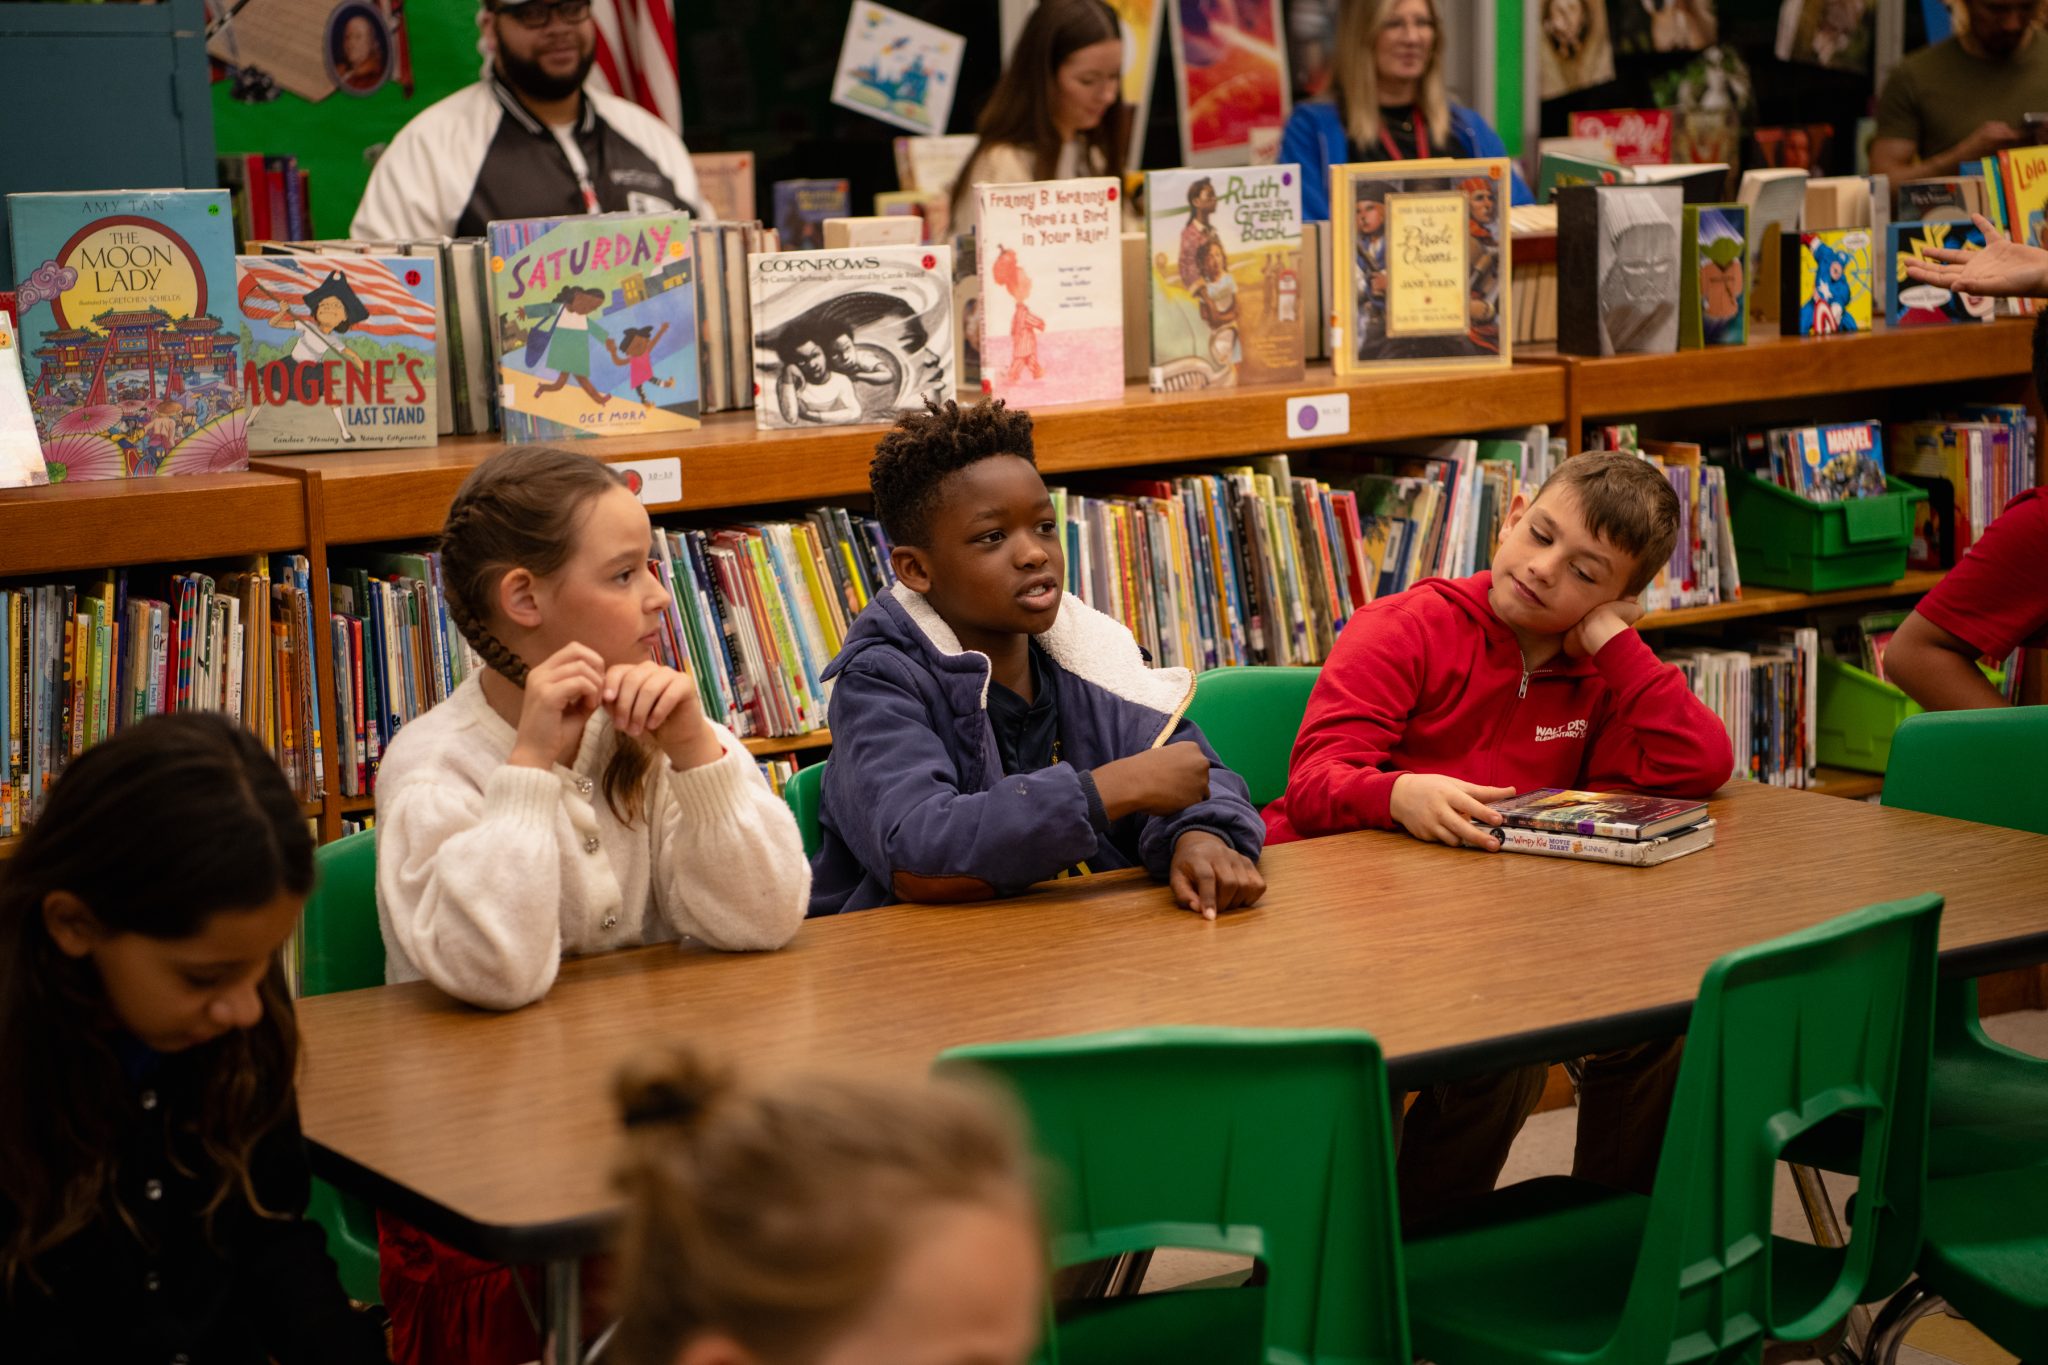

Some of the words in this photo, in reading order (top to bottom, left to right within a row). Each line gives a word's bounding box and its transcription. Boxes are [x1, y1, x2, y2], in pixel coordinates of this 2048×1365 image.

[1221, 175, 1280, 205] Ruth
[82, 200, 120, 214] AMY
[128, 199, 165, 213] TAN
[990, 192, 1036, 211] Franny
[1082, 207, 1109, 224] Bird
[1234, 204, 1293, 225] Green
[109, 231, 140, 245] THE
[1022, 232, 1035, 247] in
[1039, 230, 1072, 247] Your
[1241, 220, 1299, 243] Book
[81, 245, 173, 270] MOON
[507, 224, 672, 300] SATURDAY
[759, 256, 881, 273] CORNROWS
[95, 268, 162, 293] LADY
[243, 352, 427, 407] MOGENE'S
[348, 407, 378, 426] LAST
[383, 406, 426, 425] STAND
[579, 412, 605, 424] OGE
[609, 410, 647, 422] MORA
[1826, 425, 1873, 454] MARVEL
[1534, 730, 1580, 742] ELEMENTARY
[1536, 725, 1566, 737] WALT
[1513, 835, 1535, 848] Wimpy
[1536, 836, 1548, 847] Kid
[1549, 838, 1571, 846] MOVIE
[1583, 845, 1609, 854] KINNEY
